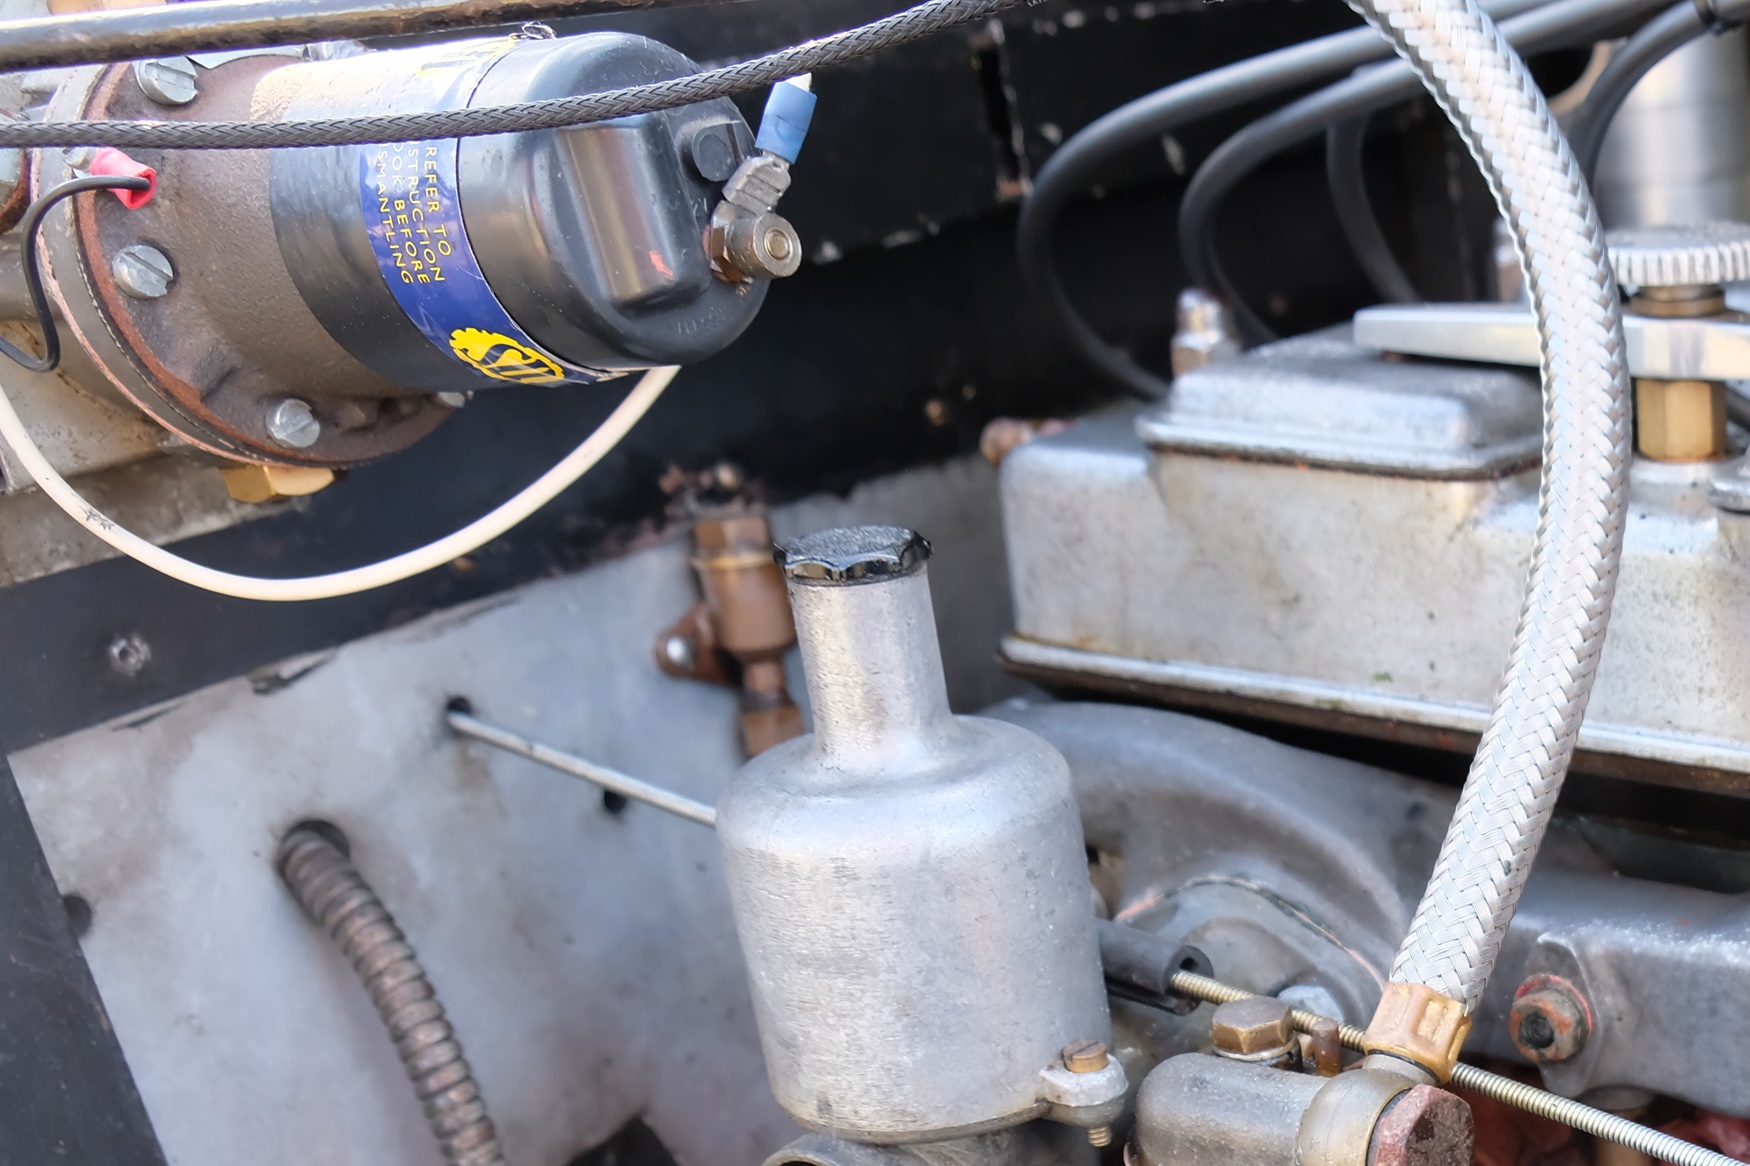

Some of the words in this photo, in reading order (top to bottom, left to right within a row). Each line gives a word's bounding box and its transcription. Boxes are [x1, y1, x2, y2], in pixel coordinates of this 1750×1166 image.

[377, 143, 414, 284] ISMANTLING
[391, 142, 405, 187] OOK
[407, 141, 445, 281] STRUCTION
[424, 146, 440, 213] REFER
[433, 224, 451, 257] TO
[393, 199, 431, 284] BEFORE
